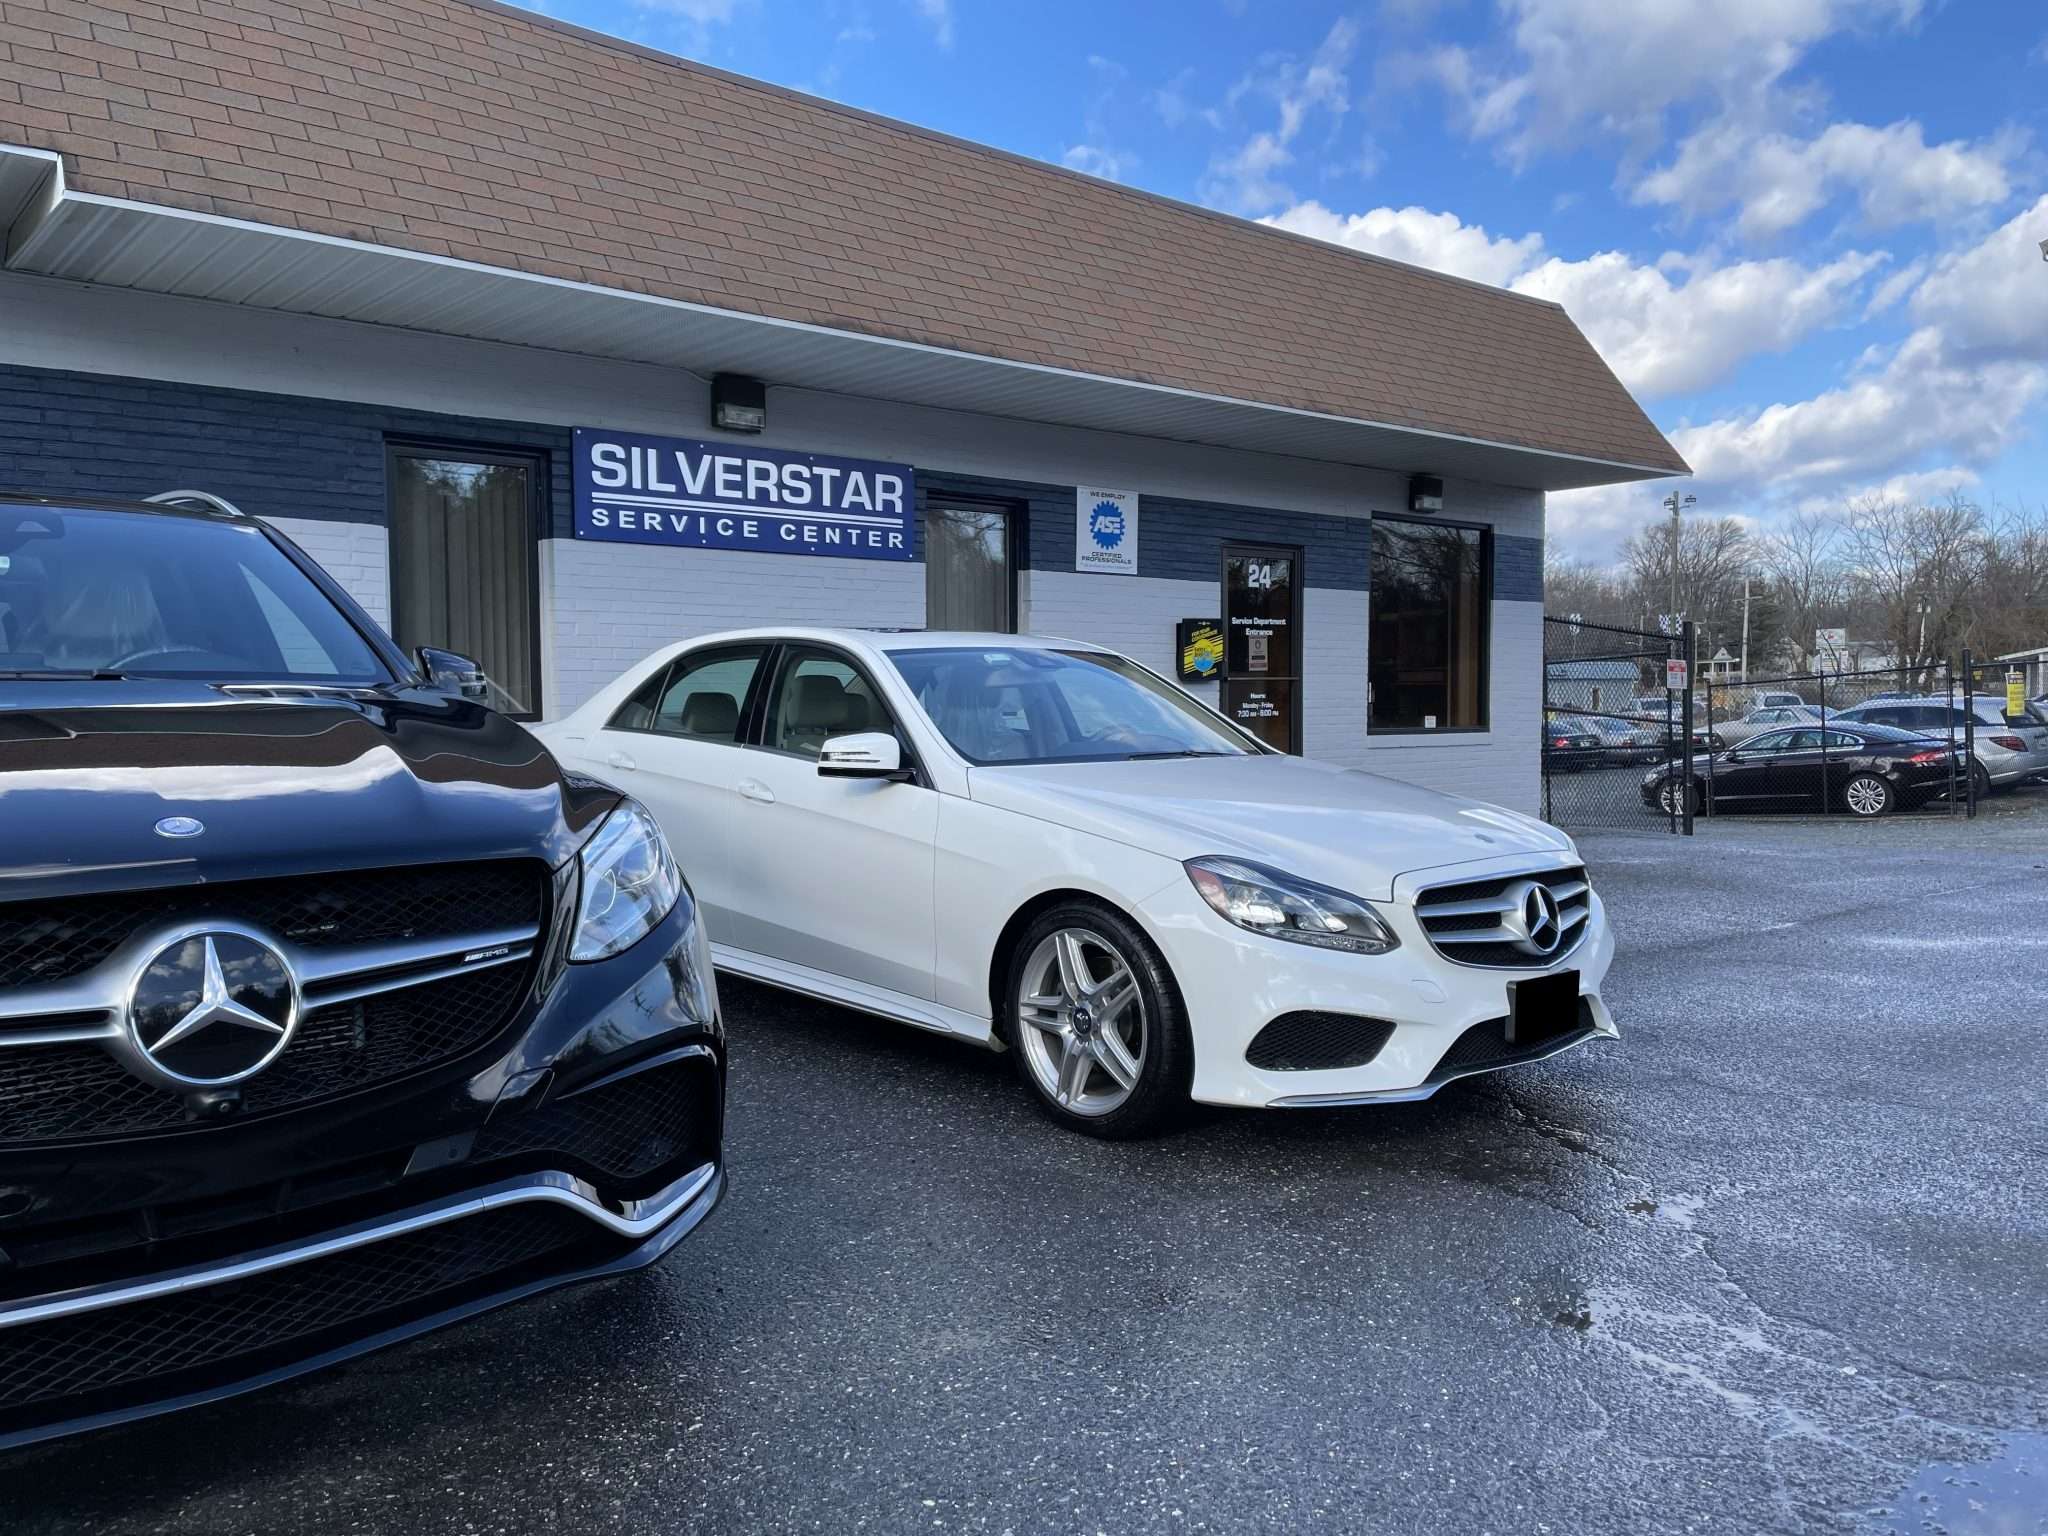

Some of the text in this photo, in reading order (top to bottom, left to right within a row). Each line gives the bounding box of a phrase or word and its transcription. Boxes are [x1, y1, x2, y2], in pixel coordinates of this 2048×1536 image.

[591, 443, 904, 513] SILVERSTAR
[591, 509, 904, 549] SERVICE CENTER
[1094, 515, 1121, 534] ASE
[1248, 564, 1271, 589] 24
[1245, 628, 1273, 636] Entrance
[1253, 617, 1286, 626] Department
